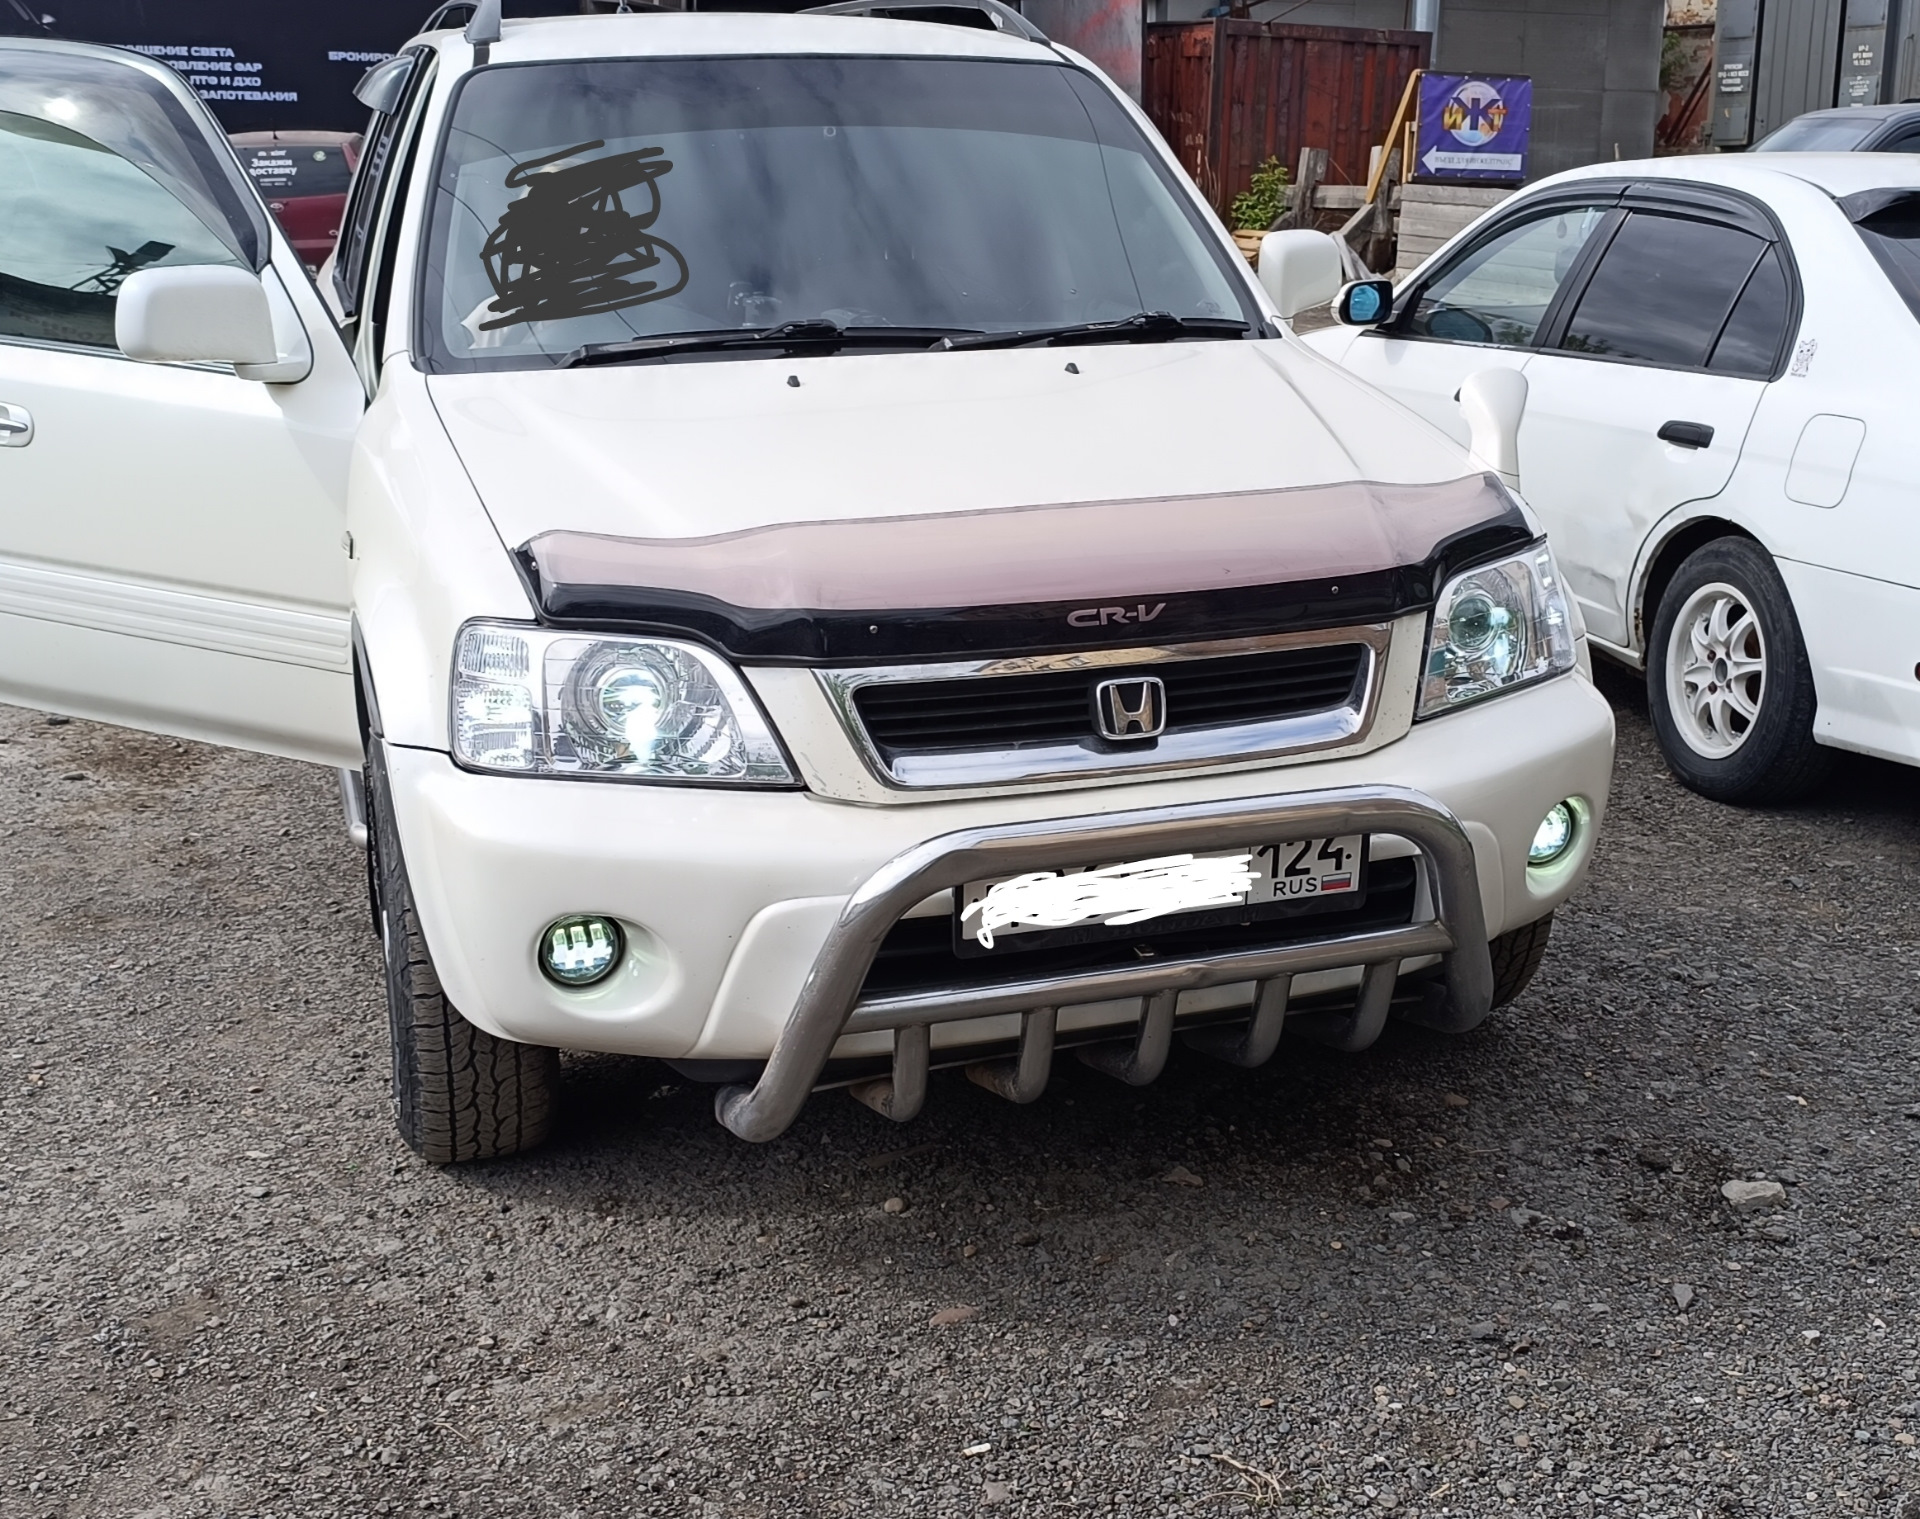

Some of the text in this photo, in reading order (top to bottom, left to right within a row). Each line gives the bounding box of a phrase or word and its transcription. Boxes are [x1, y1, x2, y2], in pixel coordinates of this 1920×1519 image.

[190, 46, 235, 58] СВЕТА
[168, 60, 263, 73] ОВЛЕНИЕ ФАР
[199, 89, 298, 102] ЗАПОТЕВАНИЯ
[1066, 602, 1167, 627] CR-V
[1273, 877, 1318, 897] RUS
